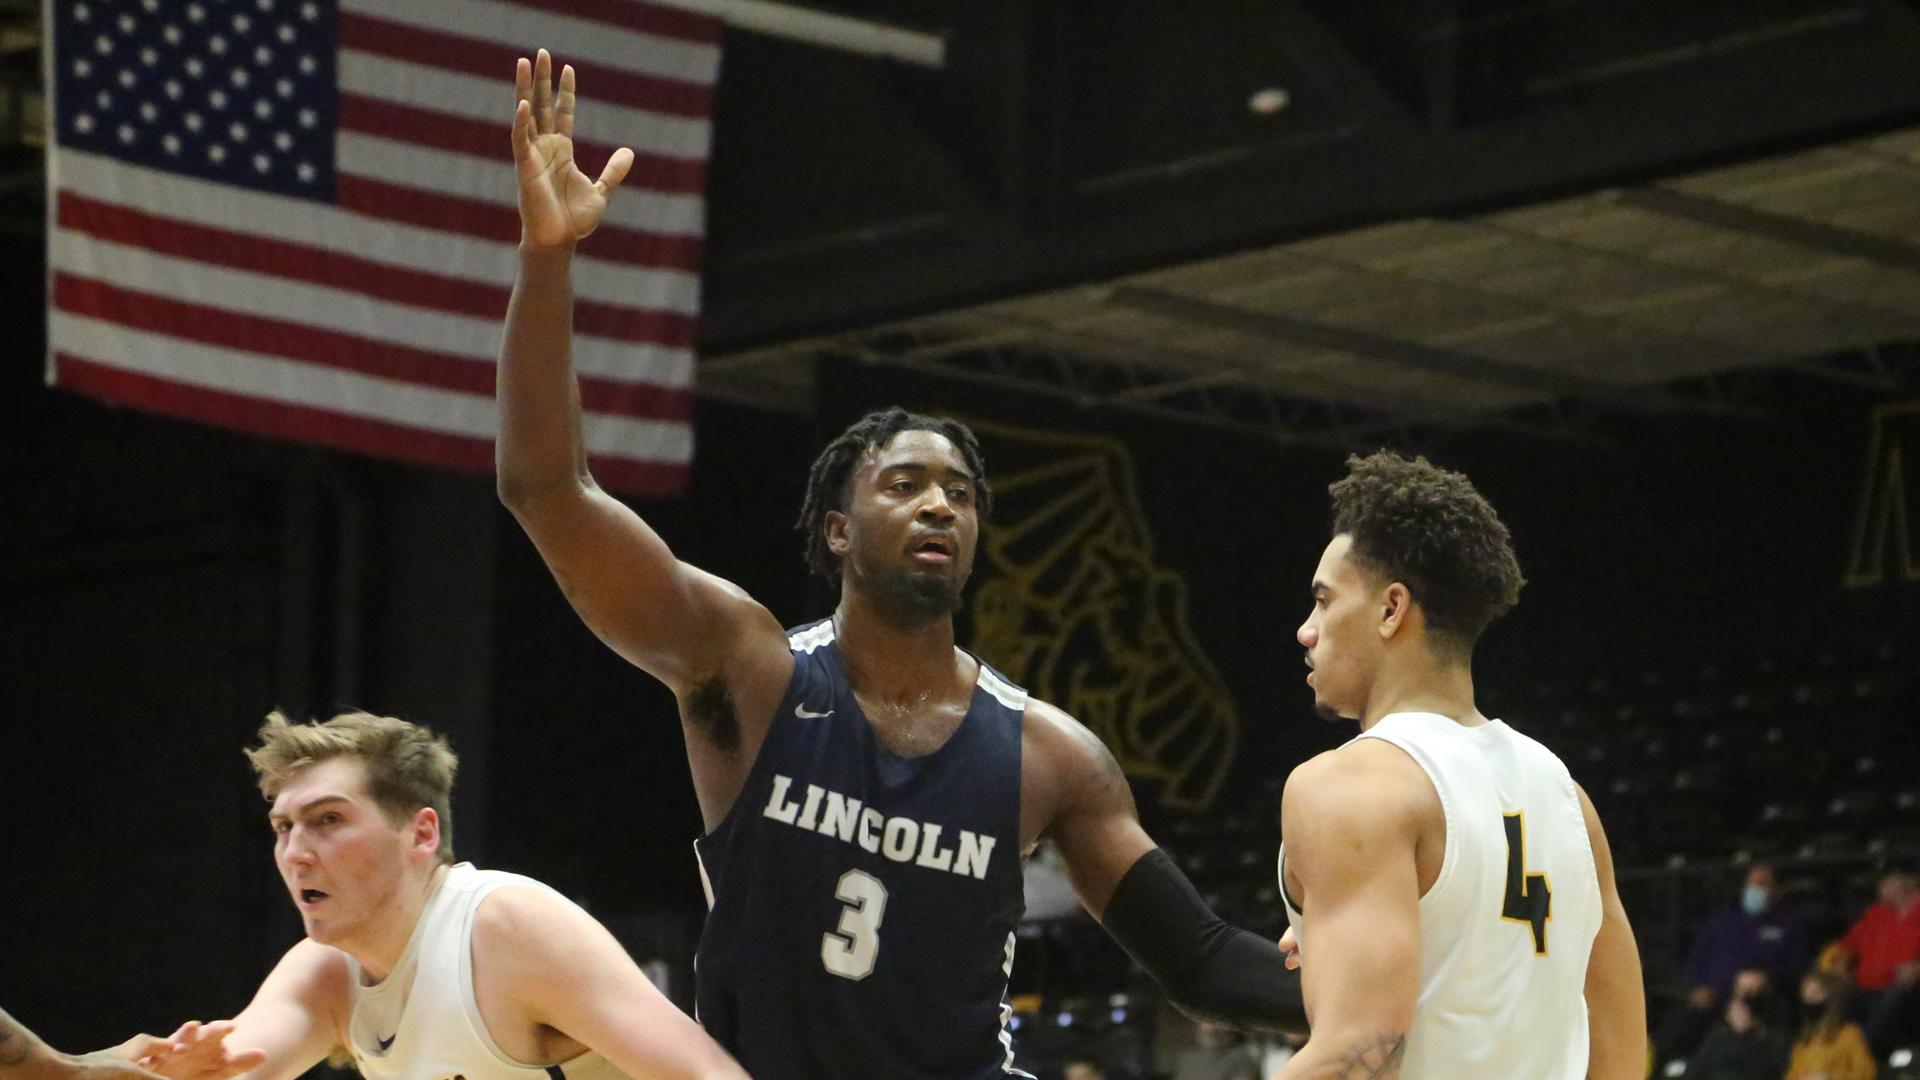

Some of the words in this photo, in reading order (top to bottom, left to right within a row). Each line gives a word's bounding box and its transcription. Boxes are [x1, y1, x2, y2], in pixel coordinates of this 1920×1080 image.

[763, 774, 997, 880] LINCOLN
[1501, 809, 1553, 957] 4
[821, 868, 889, 982] 3
